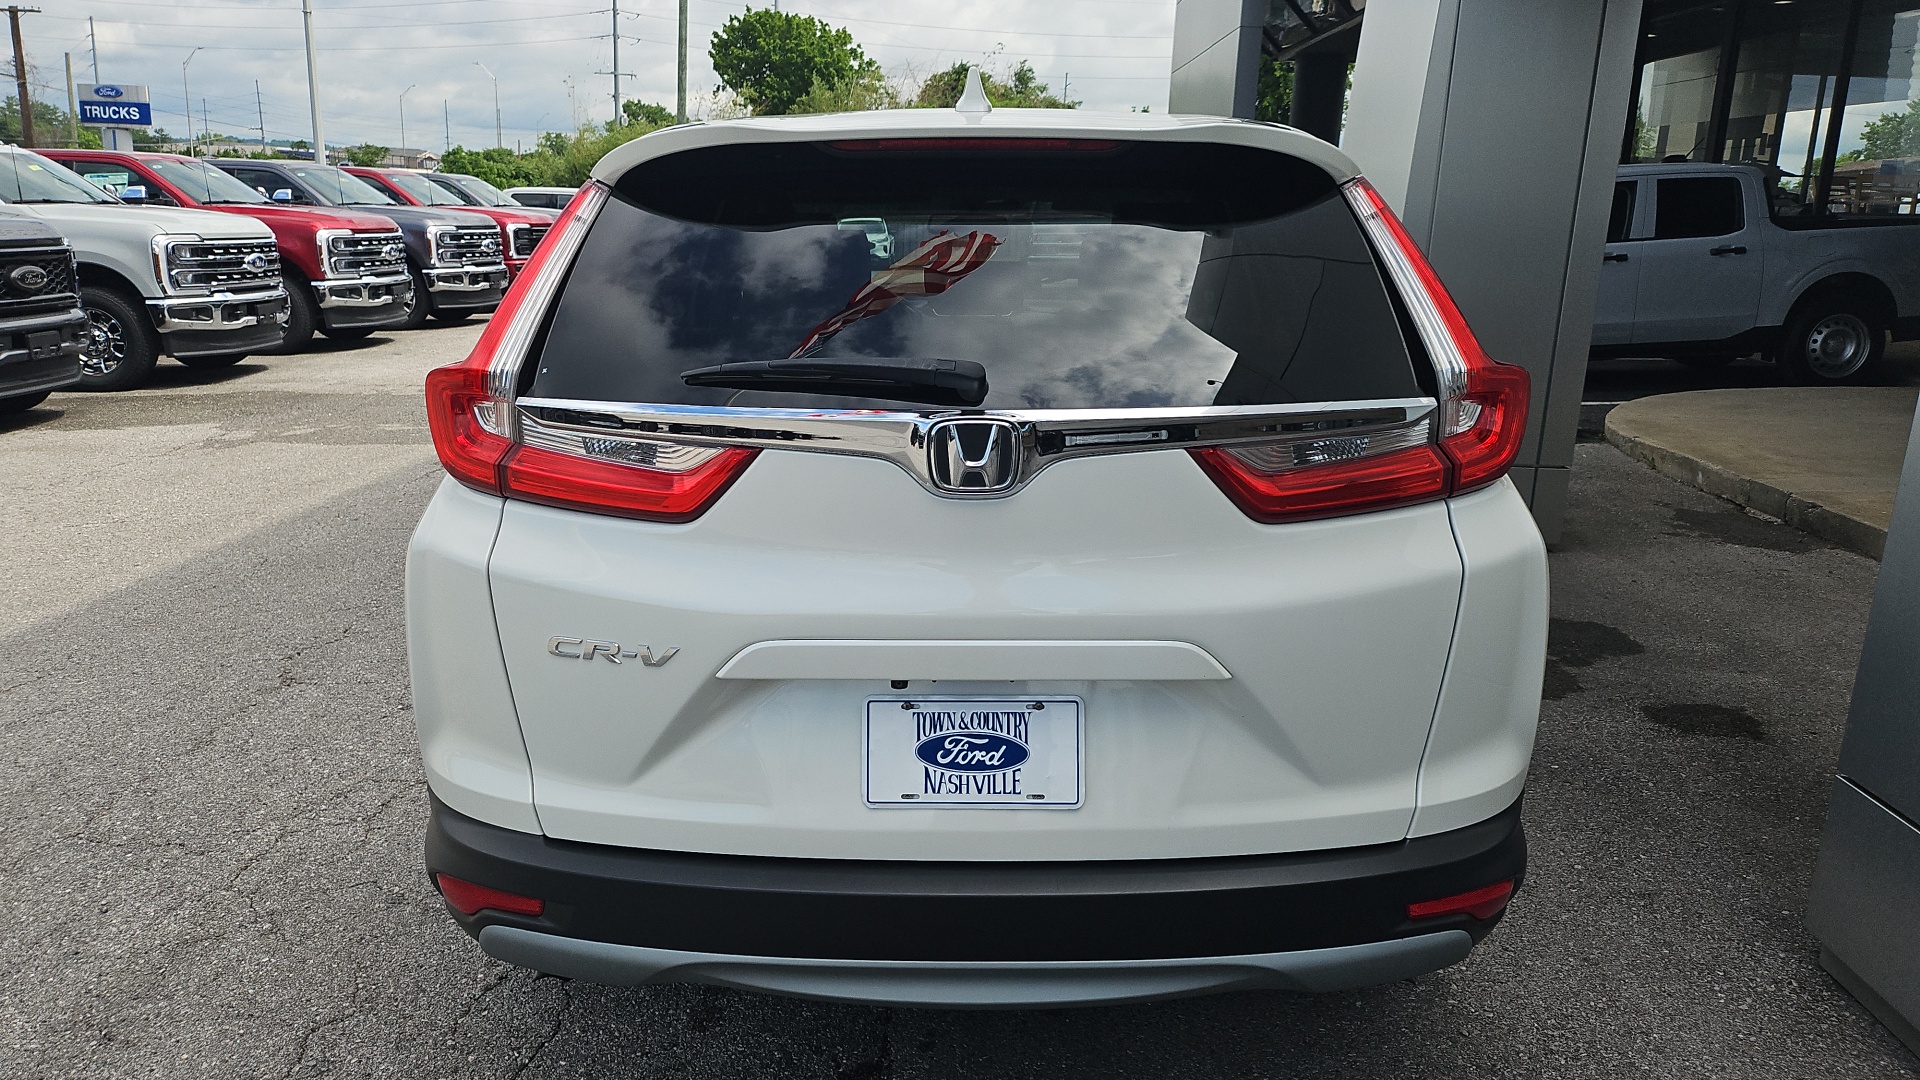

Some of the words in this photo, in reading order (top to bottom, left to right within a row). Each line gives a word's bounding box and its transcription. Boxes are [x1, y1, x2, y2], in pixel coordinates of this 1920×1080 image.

[99, 87, 116, 96] Ford
[84, 105, 140, 120] TRUCKS
[548, 635, 681, 668] CR-V
[912, 711, 956, 742] TOWN
[970, 711, 1033, 746] COUNTRY
[936, 735, 1007, 766] Ford
[923, 766, 1022, 795] NASHVILLE
